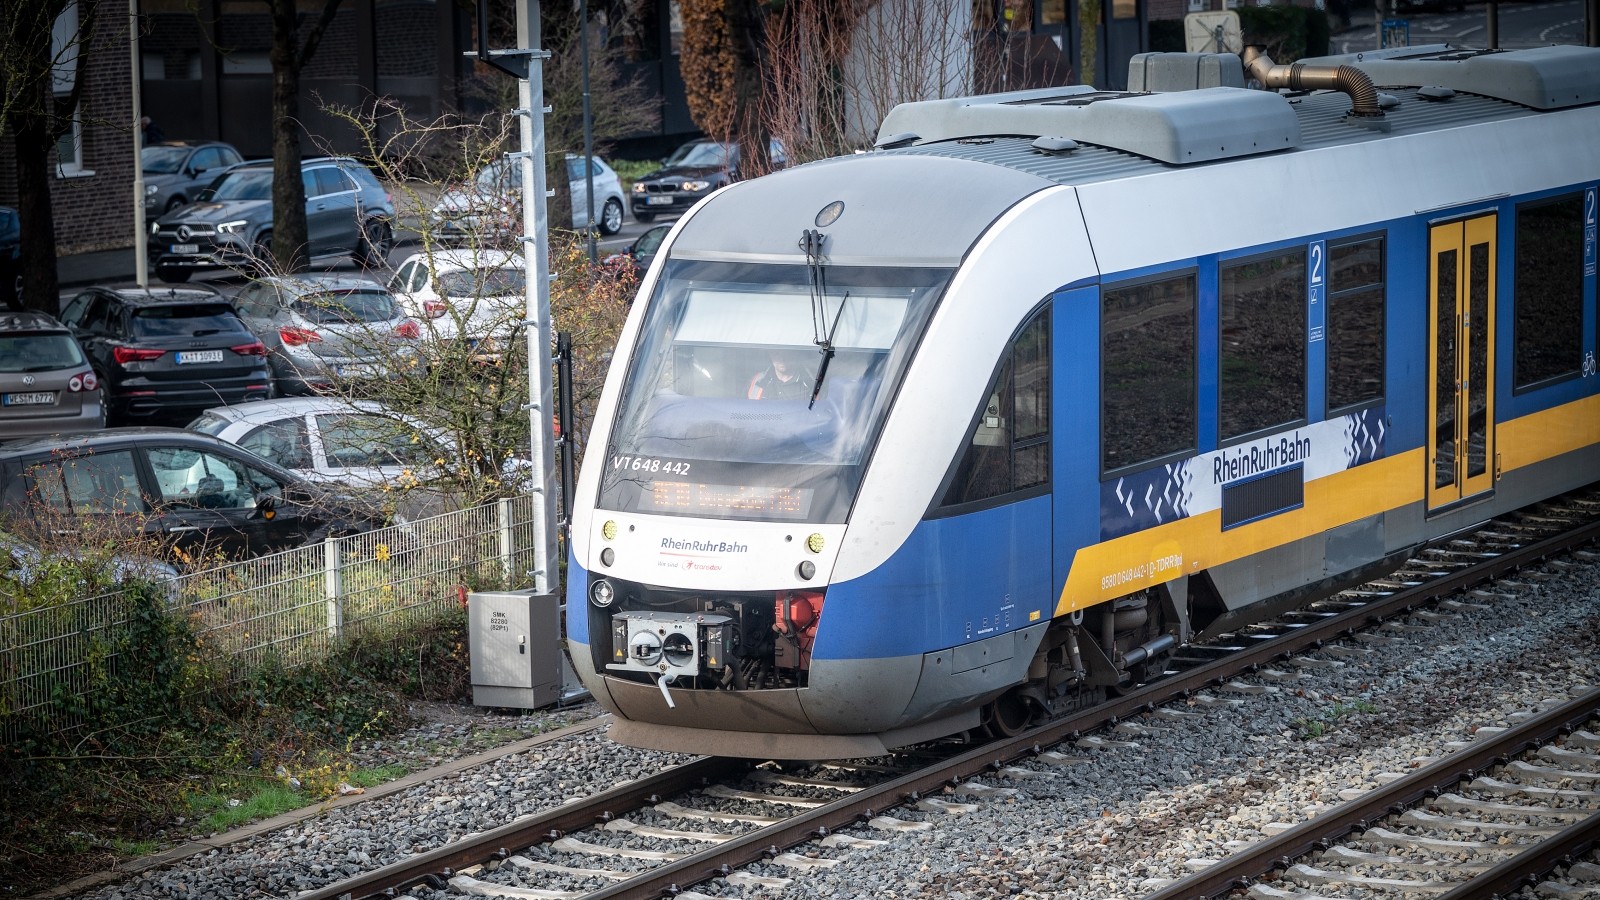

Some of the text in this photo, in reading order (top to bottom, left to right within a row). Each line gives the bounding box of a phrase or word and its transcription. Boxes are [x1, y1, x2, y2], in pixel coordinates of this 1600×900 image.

[1586, 190, 1595, 225] 2
[1311, 244, 1322, 283] 2
[662, 461, 691, 476] 442
[1213, 430, 1311, 485] RheinRuhrBahn
[660, 537, 748, 553] RheinRuhrBahn
[490, 617, 508, 625] 82280
